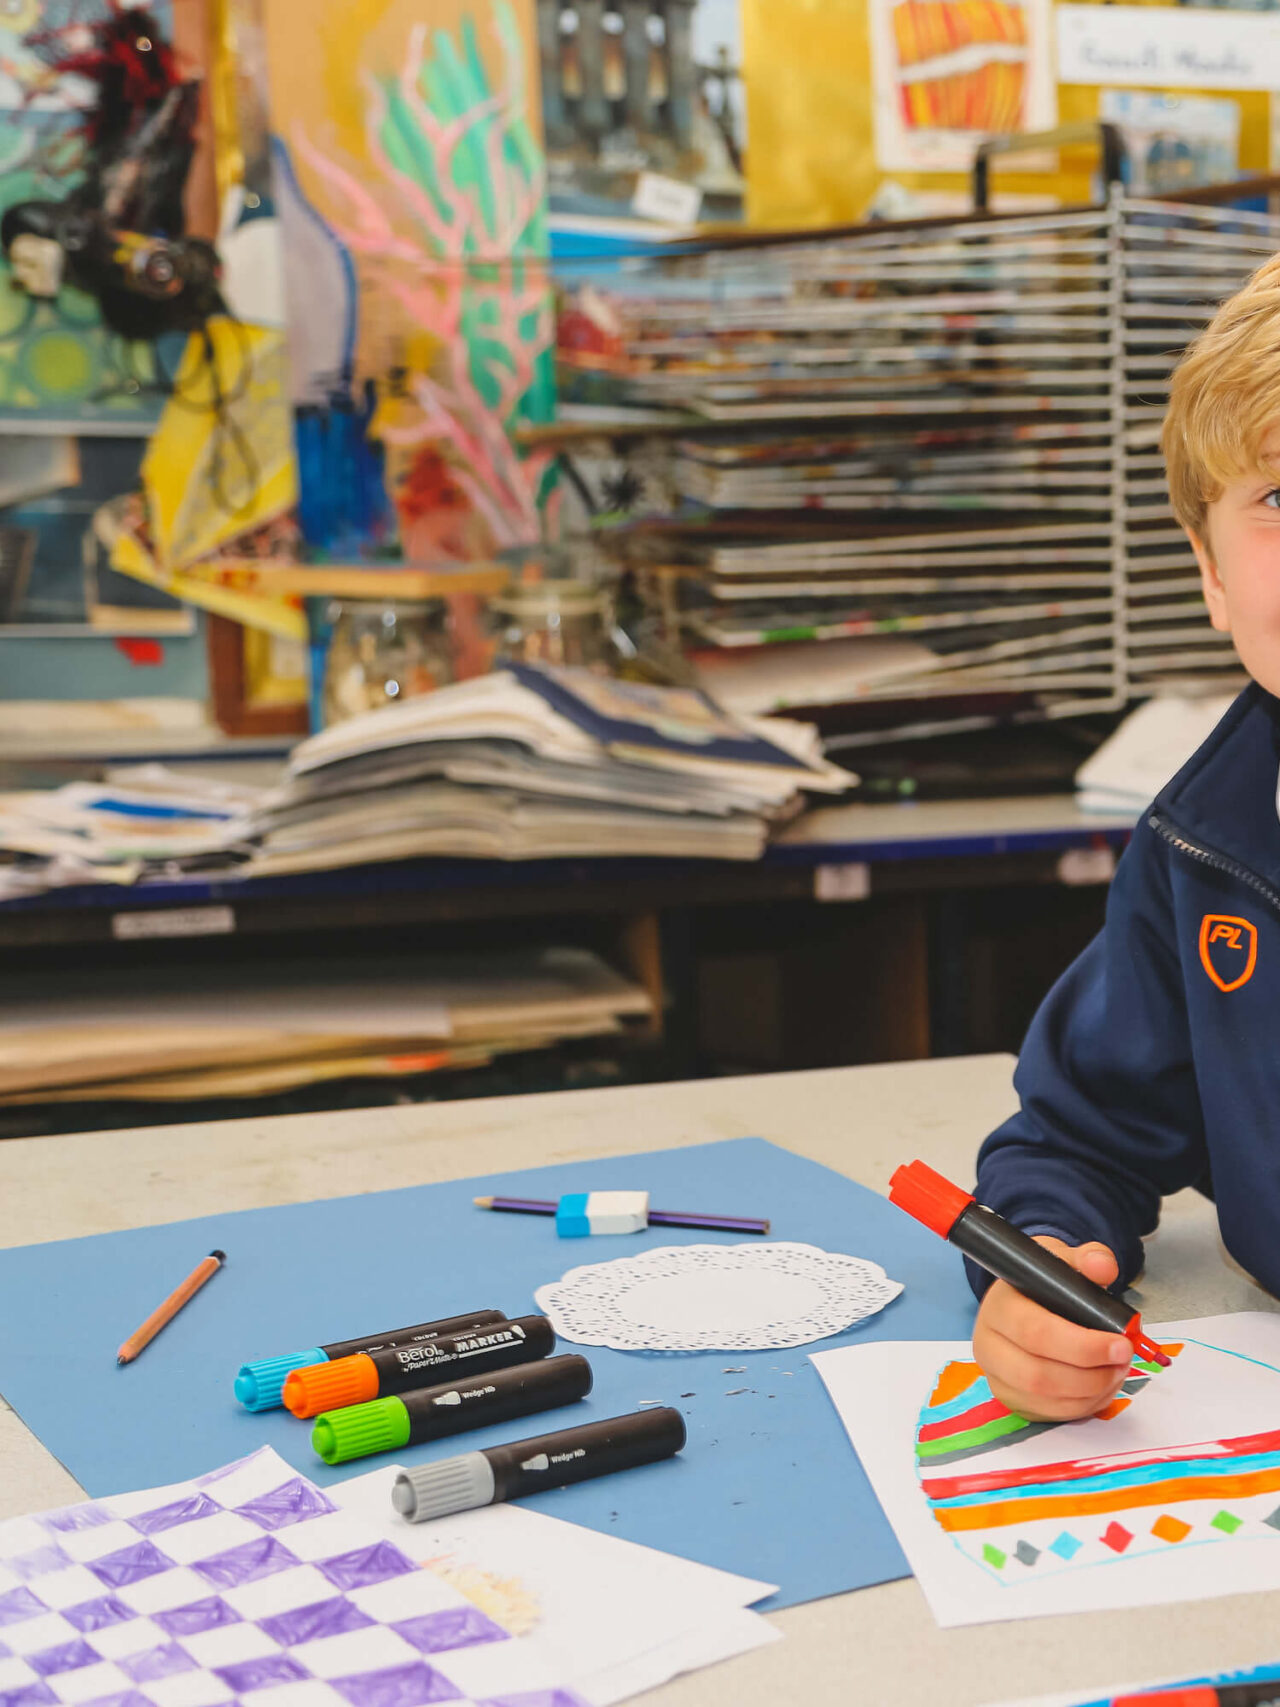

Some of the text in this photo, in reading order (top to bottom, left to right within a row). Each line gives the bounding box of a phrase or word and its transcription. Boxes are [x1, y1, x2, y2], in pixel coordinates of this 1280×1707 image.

[1209, 924, 1242, 949] PL
[456, 1331, 514, 1353] MARKER
[398, 1343, 439, 1364] Berol
[462, 1385, 496, 1400] Wedge Nib
[551, 1449, 586, 1464] Wedge Nib
